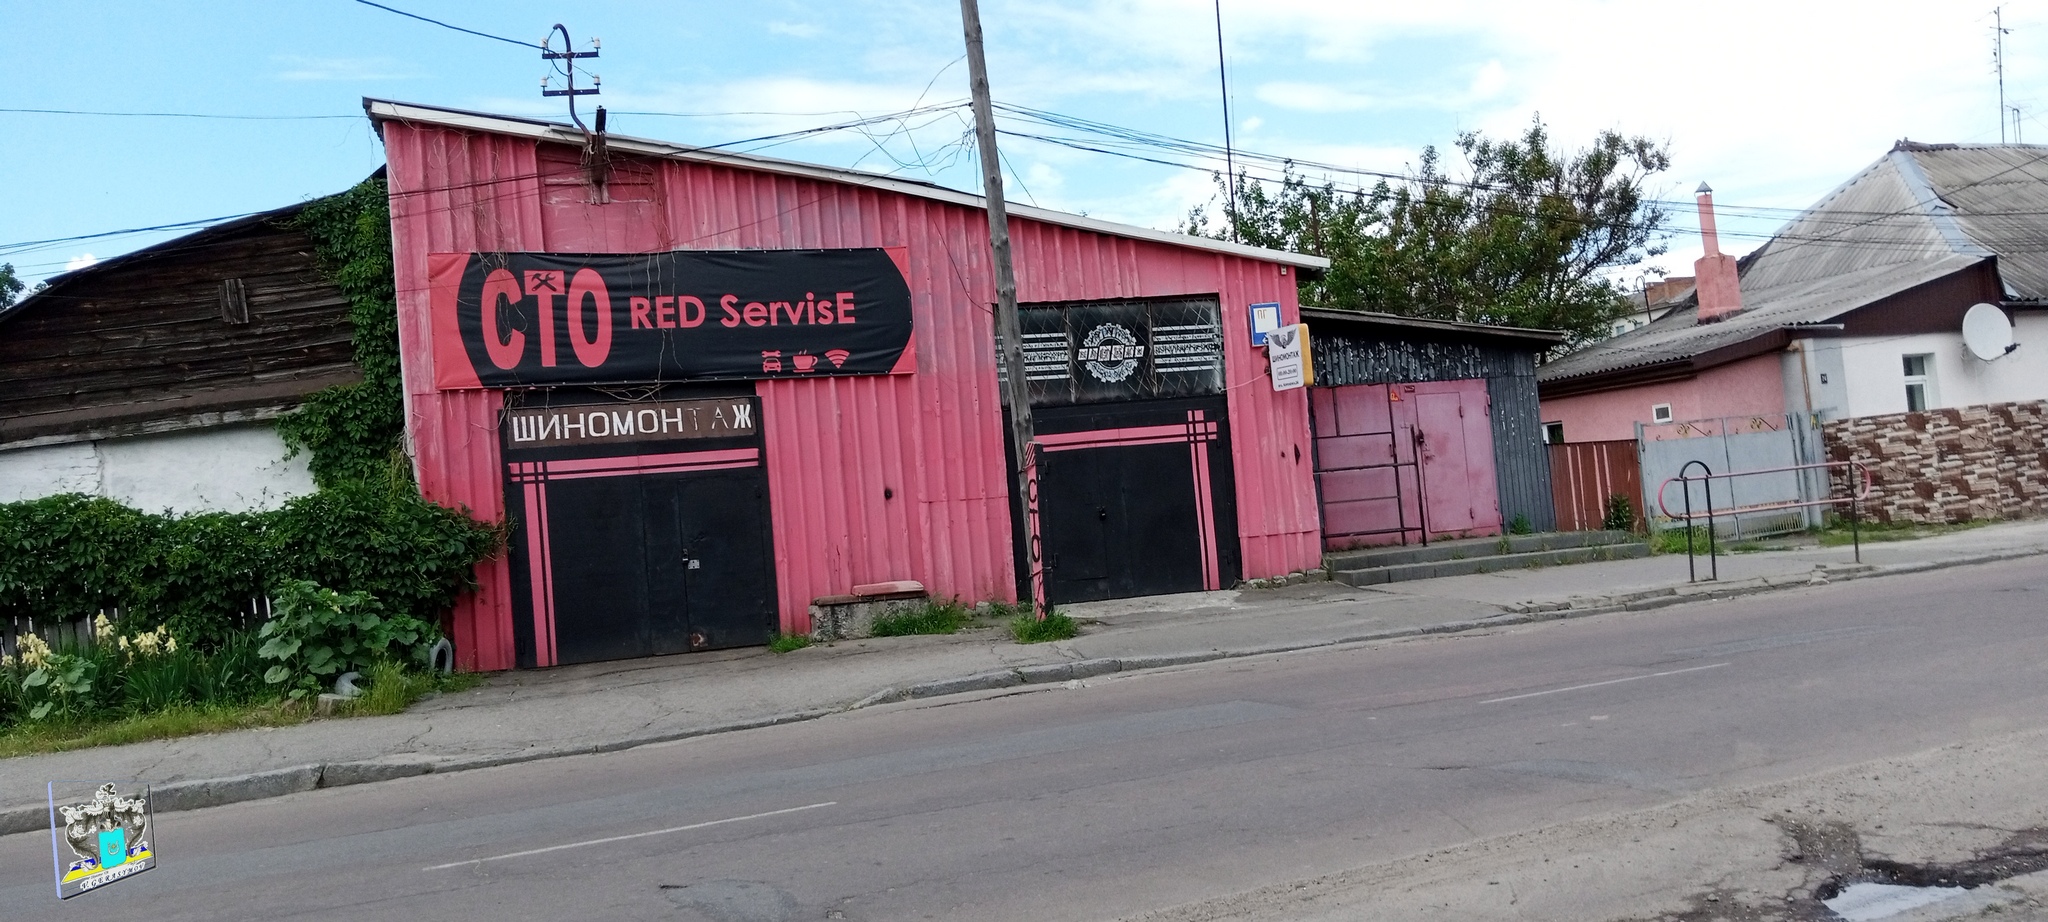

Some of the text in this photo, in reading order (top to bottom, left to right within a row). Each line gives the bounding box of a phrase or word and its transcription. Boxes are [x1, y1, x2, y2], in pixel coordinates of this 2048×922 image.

[481, 268, 613, 370] СТО
[630, 291, 857, 330] RED ServisE
[512, 403, 753, 442] ШИНОМОНТАЖ
